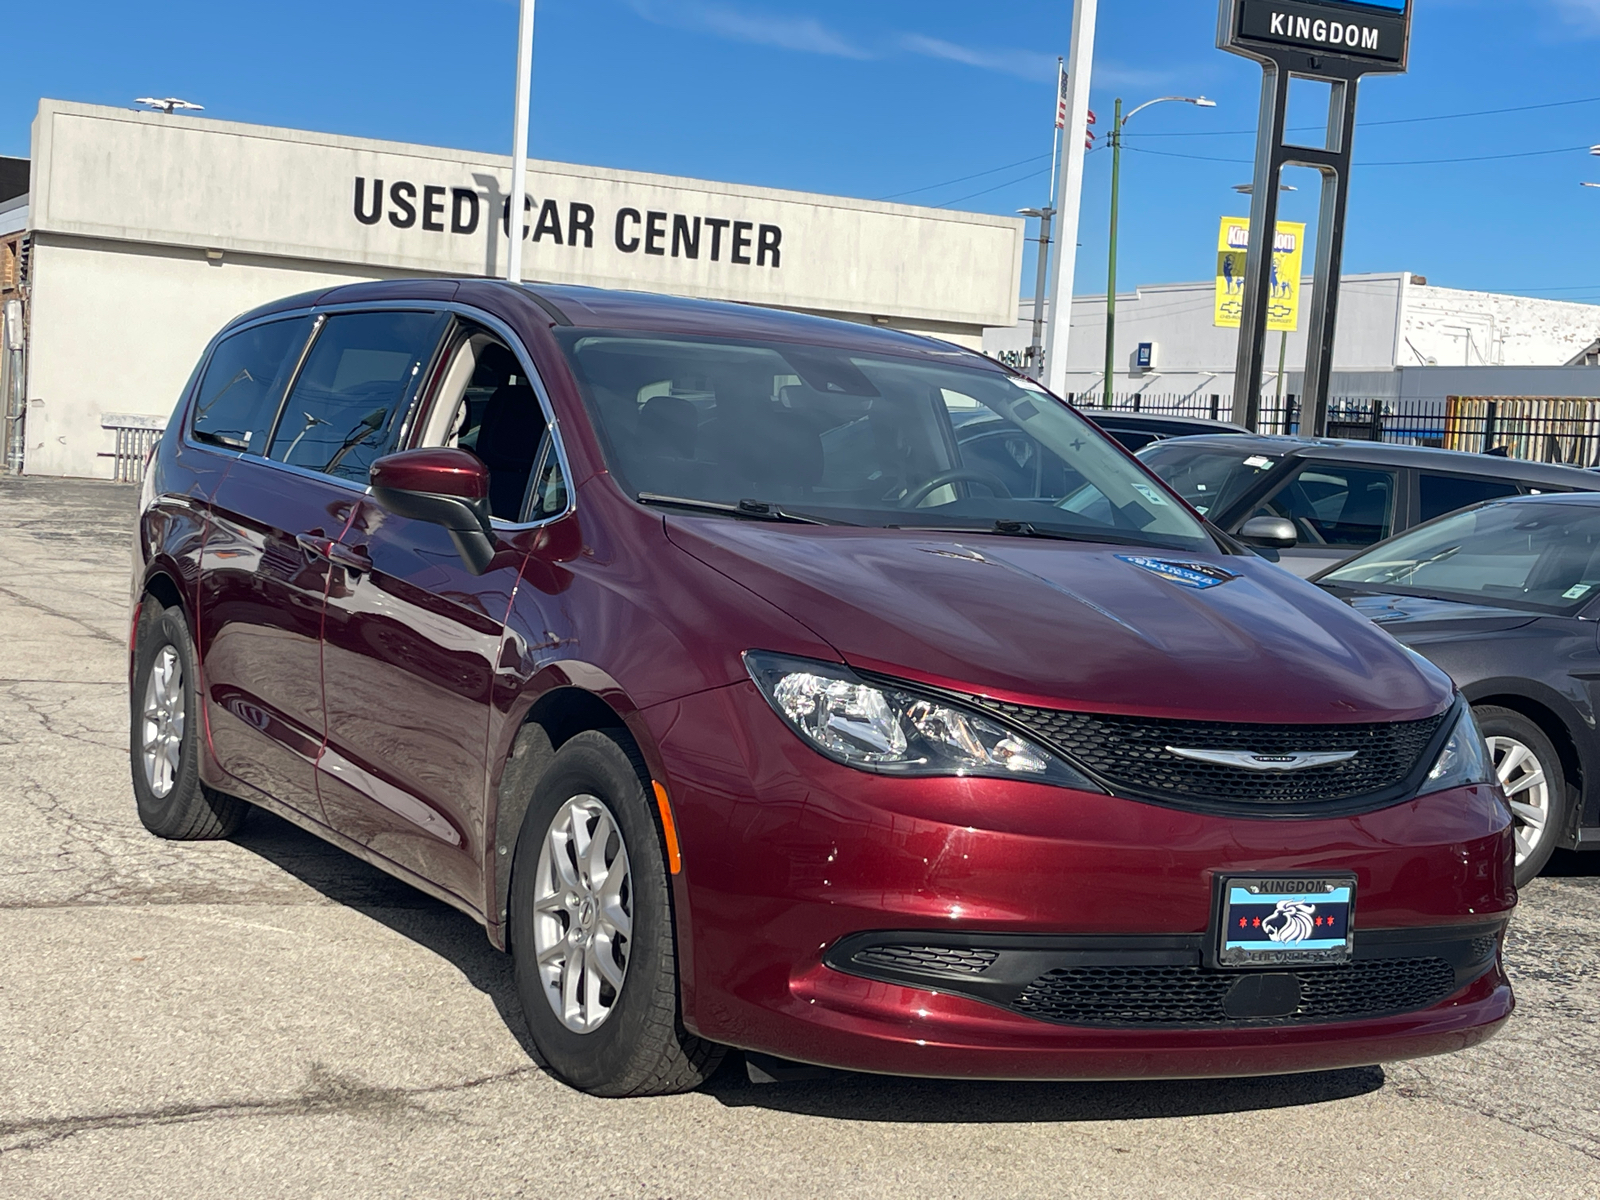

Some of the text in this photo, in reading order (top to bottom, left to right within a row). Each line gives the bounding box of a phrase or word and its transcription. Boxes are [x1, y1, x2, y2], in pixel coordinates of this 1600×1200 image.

[1270, 12, 1379, 50] KINGDOM
[353, 177, 480, 235] USED
[614, 207, 783, 268] CENTER
[1259, 880, 1327, 893] KINGDOM
